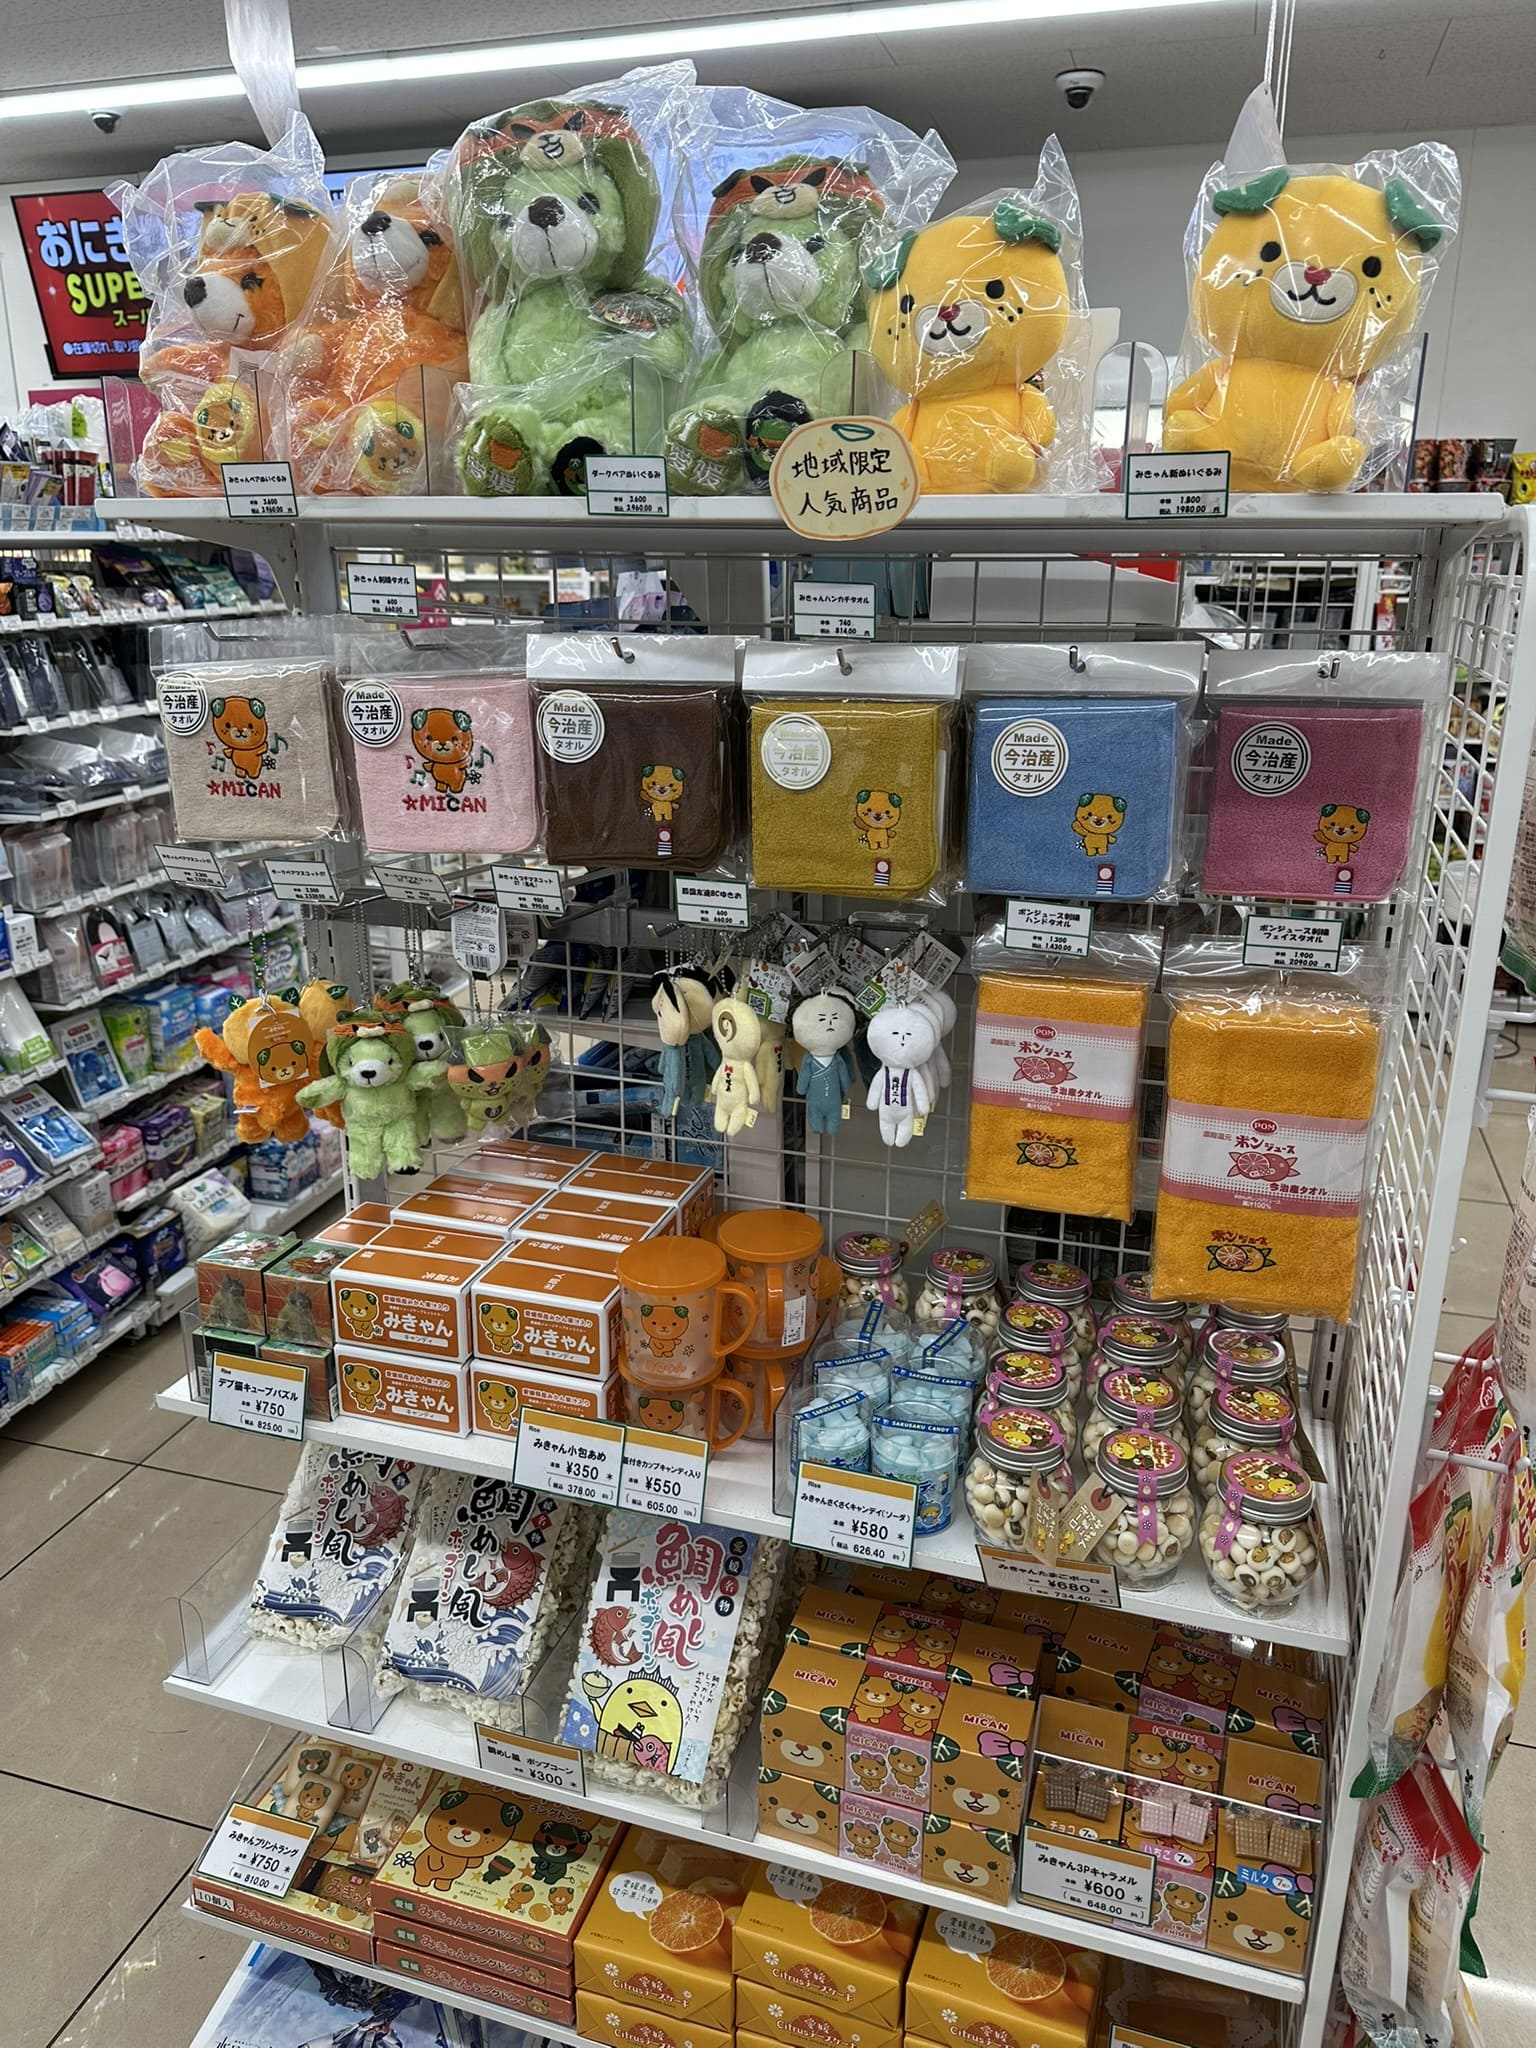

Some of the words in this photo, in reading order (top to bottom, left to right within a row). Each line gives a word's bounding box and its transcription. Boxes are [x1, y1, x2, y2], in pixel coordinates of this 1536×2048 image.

[792, 448, 892, 478] 地域限定
[592, 470, 661, 479] ダークベアぬいぐるみ
[1135, 467, 1222, 479] みきゃん新ぬいぐるみ
[798, 486, 898, 517] 人気商品
[799, 594, 870, 604] みきゃんハンカチタオル
[162, 694, 199, 711] 今治産
[356, 690, 385, 701] Made
[352, 705, 394, 721] 今治産
[552, 702, 586, 714] Made
[170, 713, 194, 725] タオル
[547, 717, 593, 736] 今治産
[362, 725, 388, 736] タオル
[1013, 732, 1049, 744] Made
[554, 739, 585, 751] タオル
[1256, 735, 1292, 747] Made
[1003, 748, 1056, 769] 今治産
[1244, 750, 1298, 771] 今治産
[781, 765, 812, 777] タオル
[1011, 771, 1044, 785] タオル
[1251, 772, 1285, 785] タオル
[221, 781, 282, 799] MICAN
[418, 795, 487, 814] MICAN
[1025, 917, 1071, 928] ハンドタオル
[1264, 932, 1324, 943] フェイスタオル
[1035, 1028, 1054, 1038] POM
[1050, 1085, 1103, 1100] 今治産タオル
[1253, 1121, 1276, 1132] POM
[1269, 1183, 1328, 1196] 今治産タオル
[383, 1310, 454, 1338] みきゃん
[404, 1334, 433, 1344] キャンディ
[524, 1326, 595, 1354] みきゃん
[544, 1350, 575, 1360] キャンディ
[835, 1355, 864, 1366] SAKUSAKU
[865, 1351, 885, 1361] CANDY
[909, 1372, 940, 1383] SAKUSAKU
[942, 1376, 962, 1385] CANDY
[218, 1378, 298, 1401] デブ猫キューブパズル
[256, 1400, 285, 1416] ¥750
[385, 1386, 454, 1413] みきゃん
[813, 1403, 840, 1418] SAKUSAKU
[841, 1395, 860, 1407] CANDY
[406, 1410, 434, 1420] キャンディ
[257, 1421, 283, 1432] 825.00
[892, 1421, 926, 1431] SAKUSAKU
[928, 1424, 950, 1434] CANDY
[533, 1438, 606, 1462] みきゃん小包あめ
[566, 1461, 599, 1480] ¥350
[567, 1484, 596, 1498] 378.00
[646, 1476, 681, 1497] ¥550
[314, 1474, 340, 1546] ポップコーン
[647, 1500, 678, 1515] 605.00
[852, 1519, 888, 1540] ¥580
[450, 1476, 537, 1629] 鯛めし風
[853, 1544, 885, 1558] 626.40
[441, 1528, 468, 1605] ポップコーン
[998, 1564, 1100, 1585] みきゃんたまごボーロ
[1047, 1579, 1091, 1593] ¥680
[1054, 1591, 1091, 1602] 734.40
[815, 1609, 857, 1625] MICAN
[640, 1587, 663, 1670] ポップコーン
[1087, 1632, 1129, 1652] MICAN
[975, 1647, 1018, 1664] MICAN
[794, 1669, 838, 1688] MICAN
[1256, 1687, 1303, 1708] MICAN
[963, 1713, 1009, 1732] MICAN
[852, 1735, 888, 1751] MICAN
[1059, 1729, 1105, 1749] MICAN
[527, 1758, 574, 1775] ポップコーン
[383, 1767, 421, 1788] みきゃん
[530, 1769, 563, 1786] ¥300
[1248, 1774, 1296, 1794] MICAN
[528, 1804, 583, 1825] ラングドシャ
[845, 1804, 882, 1822] MICAN
[1049, 1820, 1077, 1835] チョコ
[229, 1831, 299, 1857] みきゃんプリントラング
[1144, 1843, 1173, 1861] いちご
[250, 1852, 280, 1872] ¥750
[1038, 1854, 1137, 1886] みきゃん3Pキャラメル
[244, 1874, 270, 1888] 810.00
[1241, 1867, 1270, 1884] ミルク
[1084, 1879, 1125, 1900] ¥600
[199, 1891, 232, 1909] 10個入
[1087, 1900, 1122, 1915] 648.00
[638, 1974, 664, 1993] 愛媛
[800, 1966, 826, 1984] 愛媛
